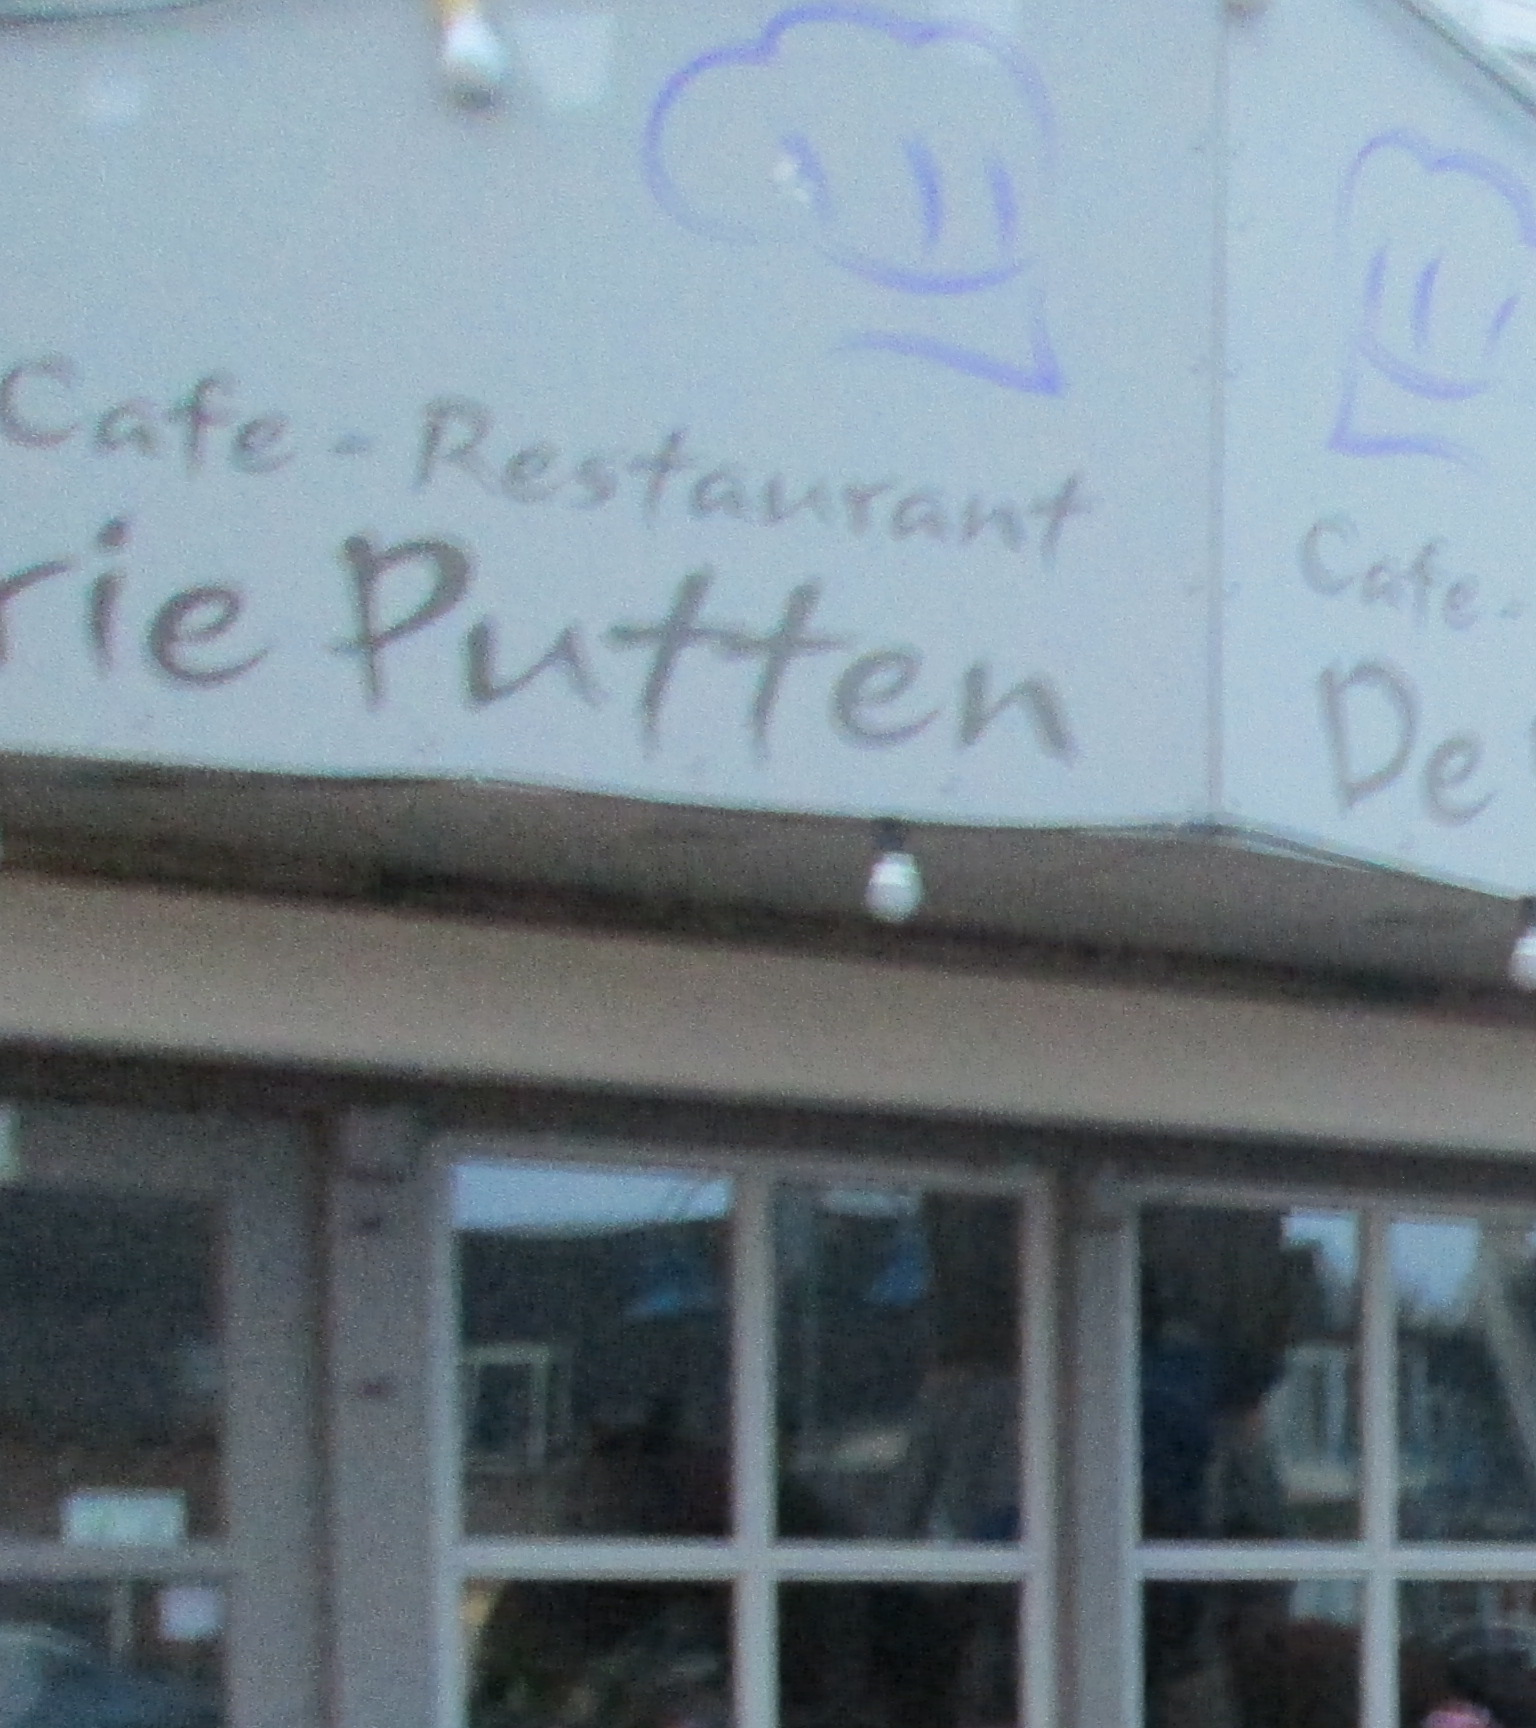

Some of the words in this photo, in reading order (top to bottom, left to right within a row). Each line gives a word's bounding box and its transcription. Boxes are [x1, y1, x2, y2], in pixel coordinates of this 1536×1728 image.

[0, 356, 295, 476] Cafe
[411, 401, 1088, 562] Restaurant
[332, 532, 1076, 764] Putten
[1300, 514, 1480, 632] Cafe
[1317, 658, 1497, 828] De
